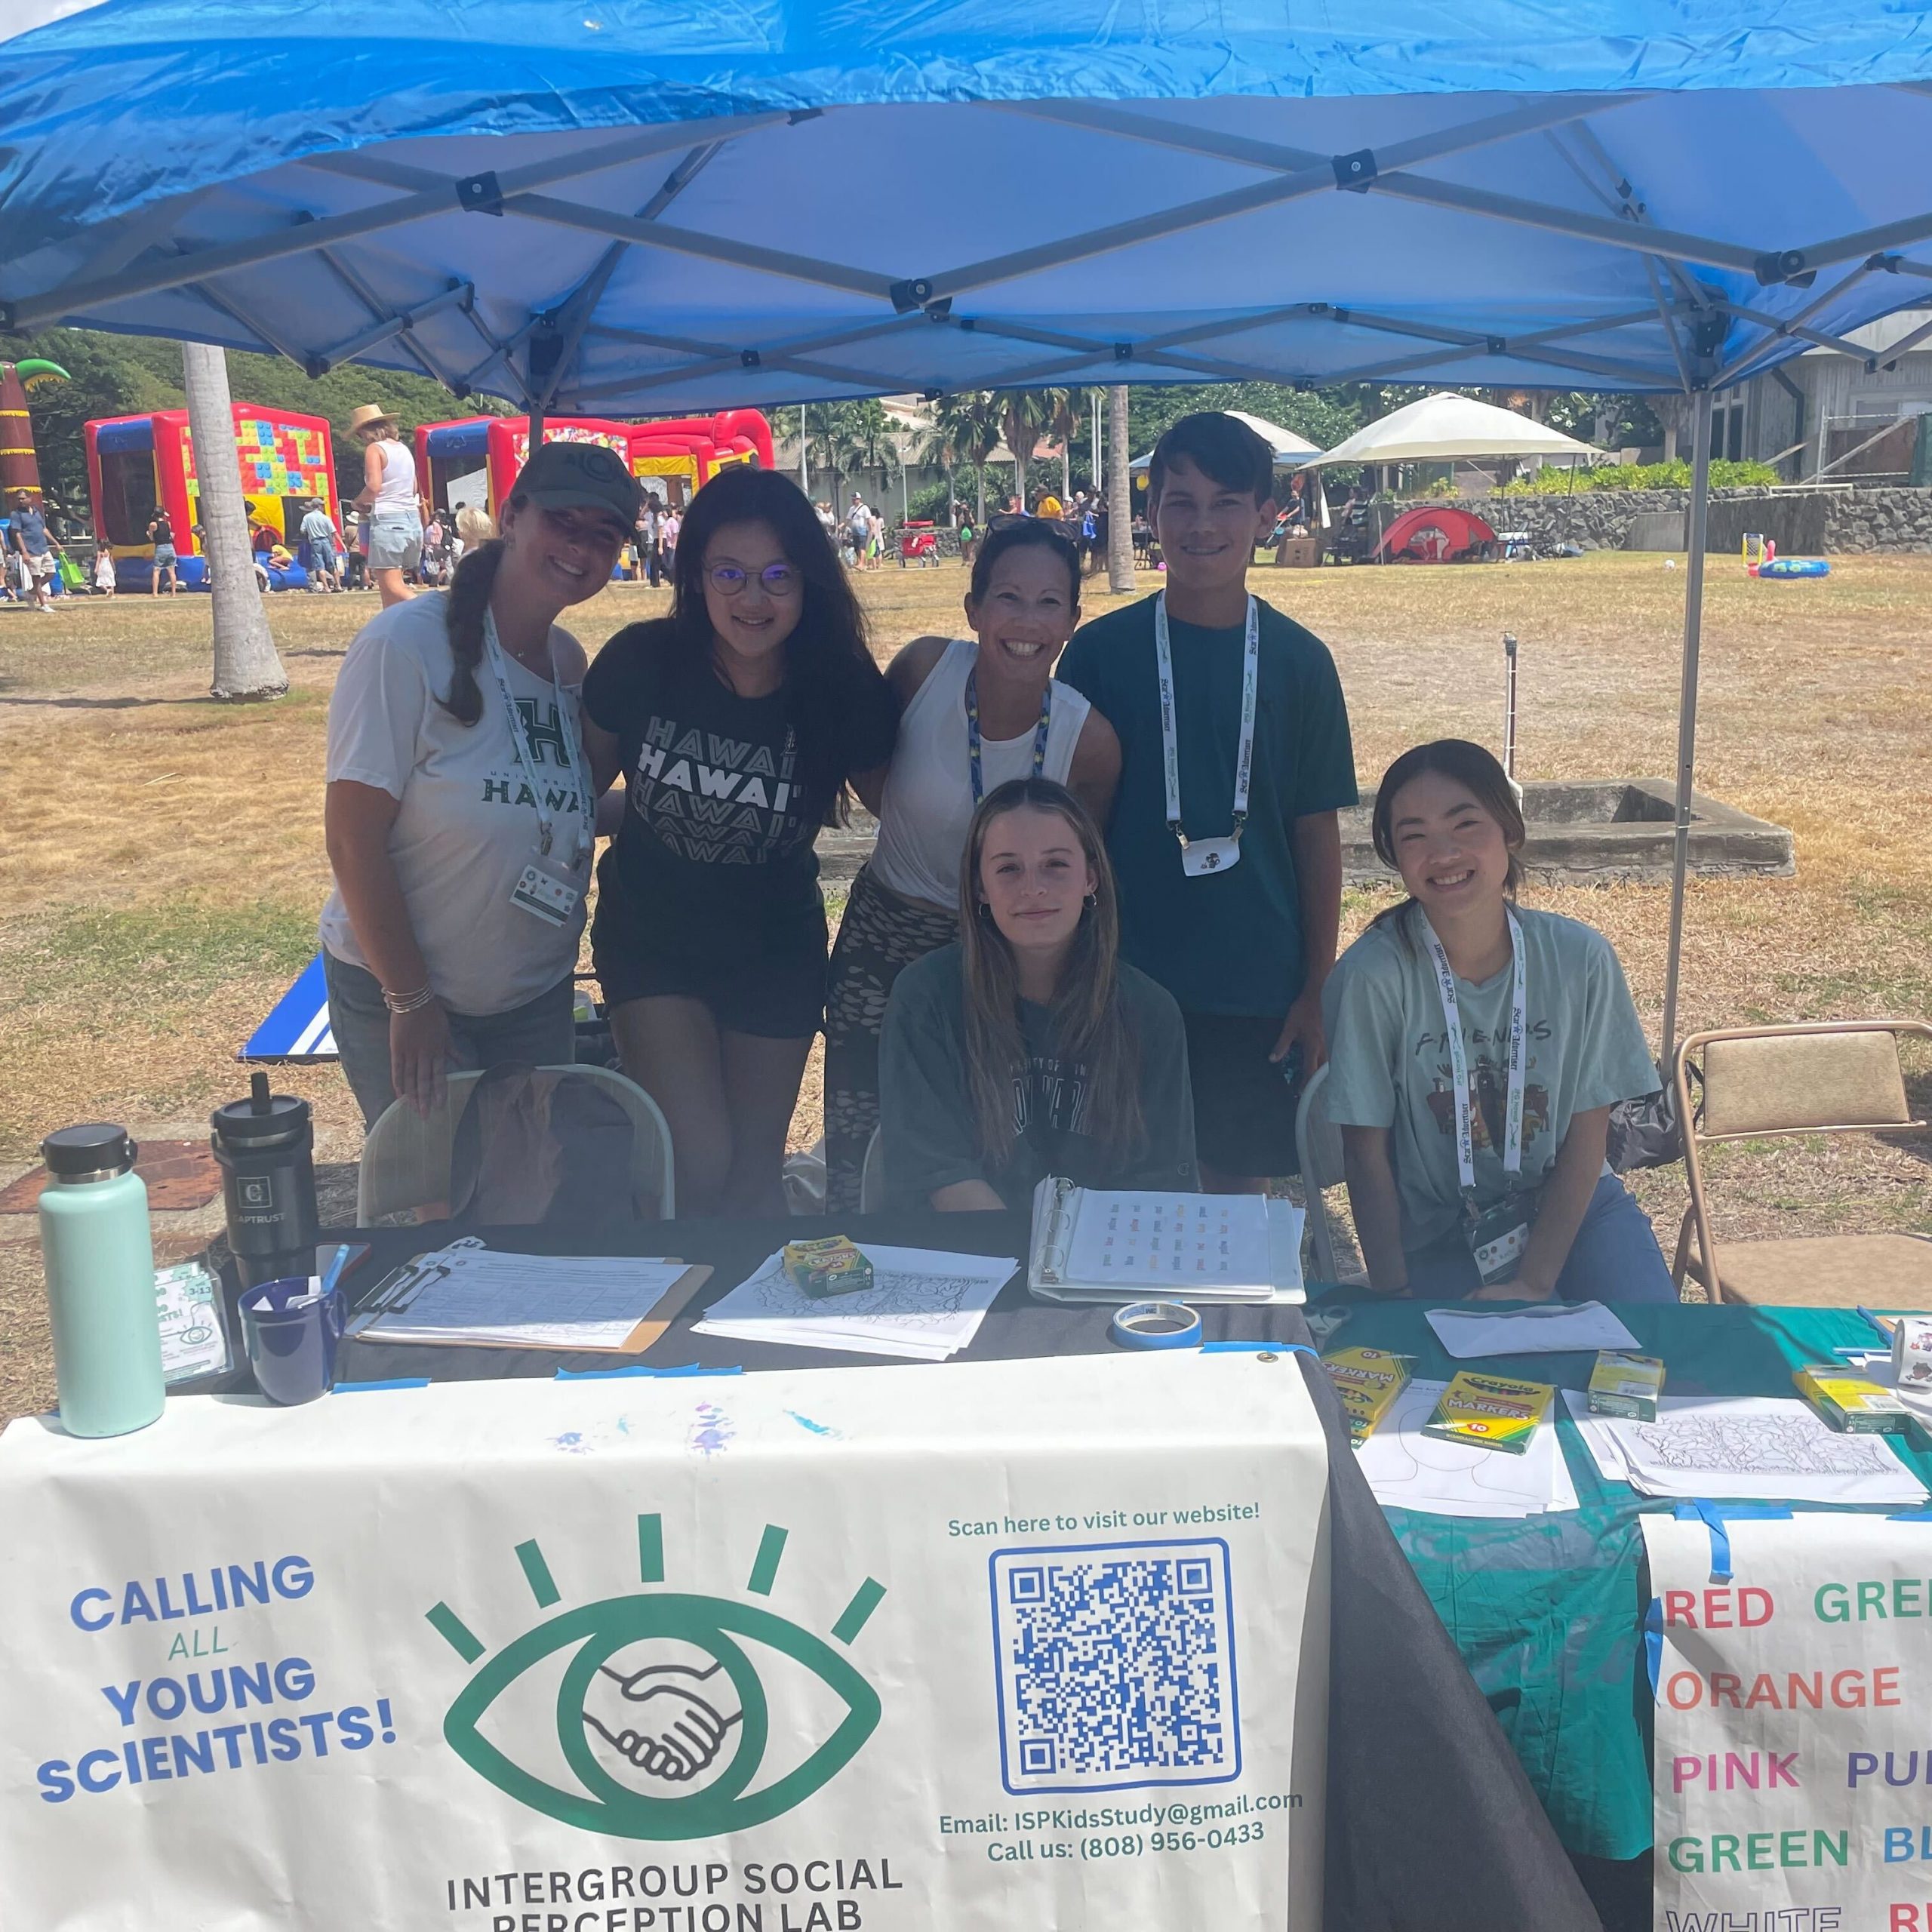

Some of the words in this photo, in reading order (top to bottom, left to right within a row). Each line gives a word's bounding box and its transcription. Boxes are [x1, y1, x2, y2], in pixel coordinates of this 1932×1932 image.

[1161, 678, 1170, 694] Star
[1239, 779, 1248, 794] Star
[1434, 943, 1450, 978] Advertiser
[1447, 986, 1457, 1004] Star
[1512, 1007, 1521, 1025] Star
[1510, 1035, 1521, 1071] Advertiser
[1462, 1103, 1470, 1139] Advertiser
[1463, 1146, 1473, 1164] Star
[245, 1184, 263, 1202] C
[232, 1212, 285, 1223] CAPTRUST
[189, 1286, 211, 1295] 3-13
[1470, 1377, 1534, 1392] Crayola
[1447, 1398, 1531, 1421] MARKERS
[1471, 1424, 1487, 1432] 10
[949, 1519, 998, 1537] Scan
[1004, 1514, 1051, 1534] here
[1056, 1514, 1078, 1532] to
[1083, 1510, 1128, 1529] visit
[1133, 1509, 1168, 1527] our
[1173, 1503, 1260, 1524] website!
[70, 1555, 315, 1632] CALLING
[1665, 1587, 1774, 1629] RED
[1814, 1579, 1932, 1623] GRE
[168, 1626, 229, 1661] ALL
[100, 1657, 315, 1727] YOUNG
[1666, 1666, 1900, 1711] ORANGE
[36, 1698, 396, 1804] SCIENTISTS!
[1672, 1752, 1801, 1794] PINK
[940, 1814, 1008, 1835] Email:
[1014, 1792, 1304, 1832] ISPKidsStudy@gmail.com
[987, 1840, 1034, 1863] Call
[1040, 1839, 1074, 1860] us:
[1080, 1834, 1144, 1861] (808)
[1150, 1821, 1265, 1852] 956-0433
[1668, 1829, 1848, 1873] GREEN
[448, 1863, 729, 1911] INTERGROUP
[743, 1857, 903, 1895] SOCIAL
[492, 1902, 763, 1932] PERCEPTION
[780, 1899, 863, 1932] LAB
[1666, 1906, 1841, 1932] WHITE
[1890, 1902, 1932, 1932] R
